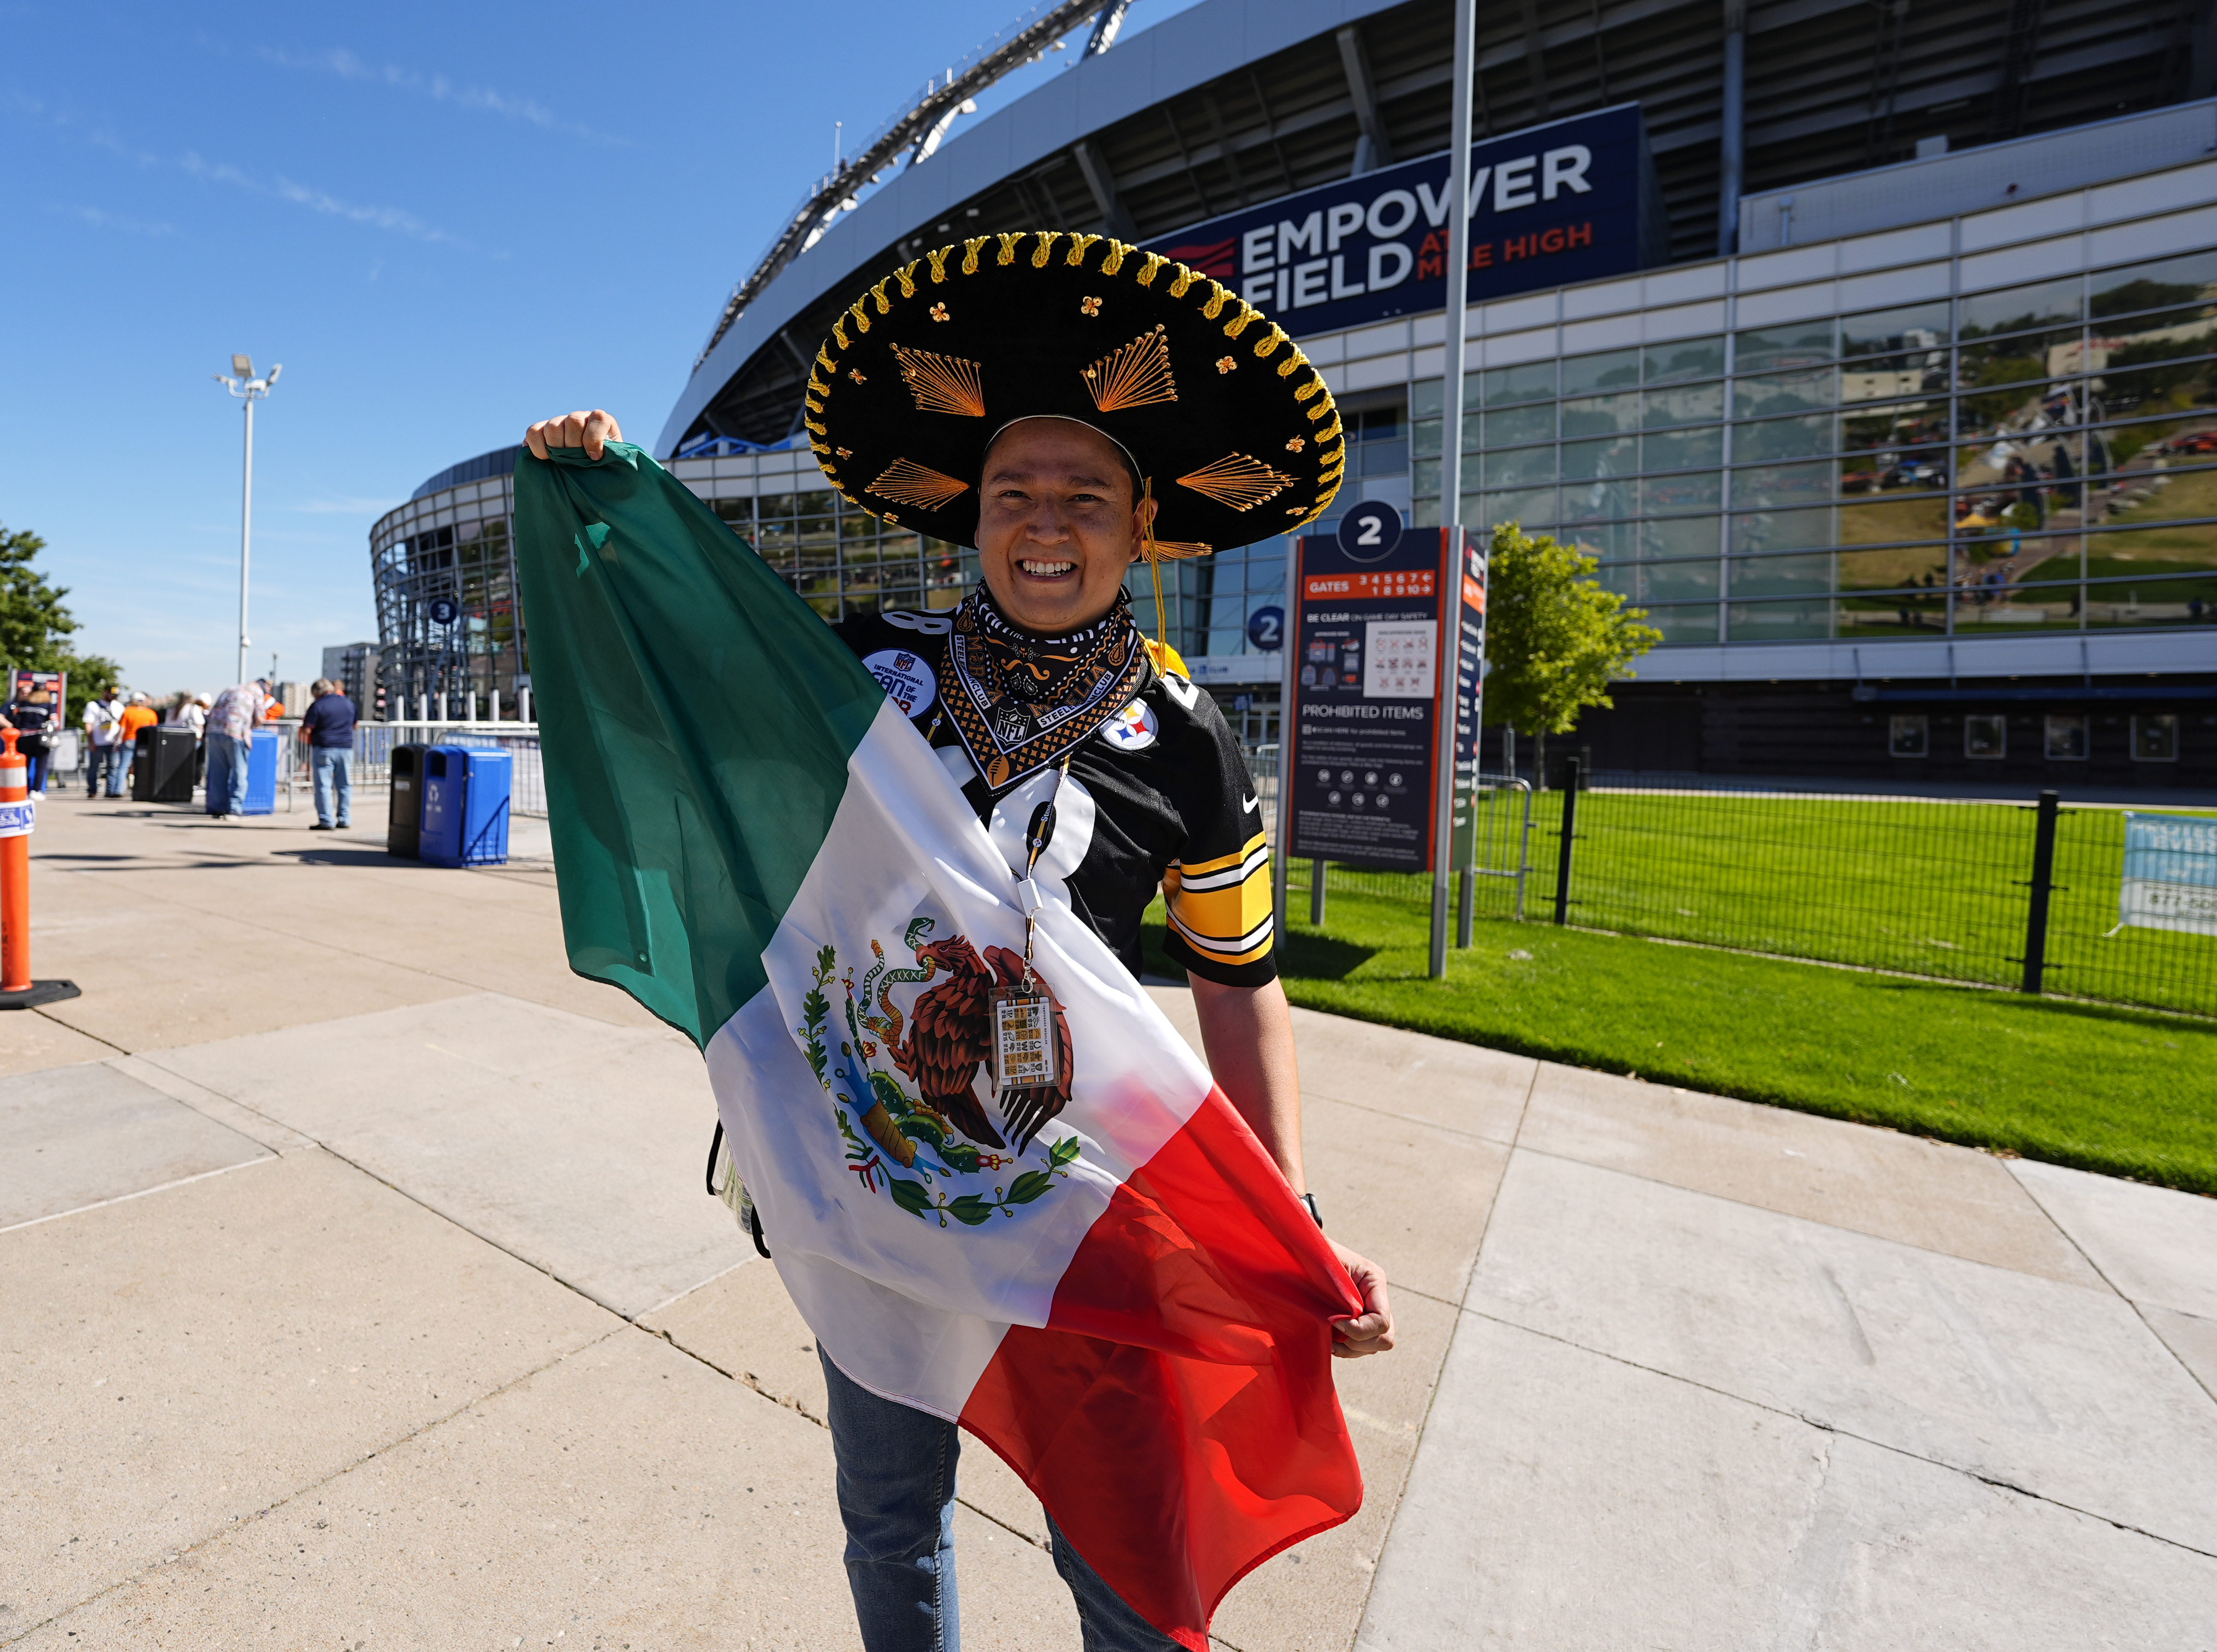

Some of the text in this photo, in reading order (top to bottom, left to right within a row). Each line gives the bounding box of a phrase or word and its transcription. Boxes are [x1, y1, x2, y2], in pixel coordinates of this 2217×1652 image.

[1242, 144, 1592, 274] EMPOWER
[1417, 223, 1592, 280] ME HIGH
[1242, 242, 1413, 312] FIELD
[1357, 516, 1382, 546] 2
[1310, 581, 1349, 593] GATES
[1359, 572, 1418, 586] 3 4 5 6 7
[1372, 584, 1420, 596] 1 8 9 10
[437, 605, 450, 620] 3
[1307, 613, 1319, 623] BE
[1320, 612, 1350, 622] CLEAR
[1363, 613, 1383, 621] GAME
[1384, 612, 1399, 621] DAY
[1400, 611, 1428, 620] SAFETY
[1259, 616, 1279, 641] 2
[895, 659, 910, 670] NFL
[874, 664, 923, 686] INTERNATIONAL
[903, 692, 918, 703] THE
[1302, 704, 1424, 720] PROHIBITED ITEMS
[997, 720, 1022, 741] NFL
